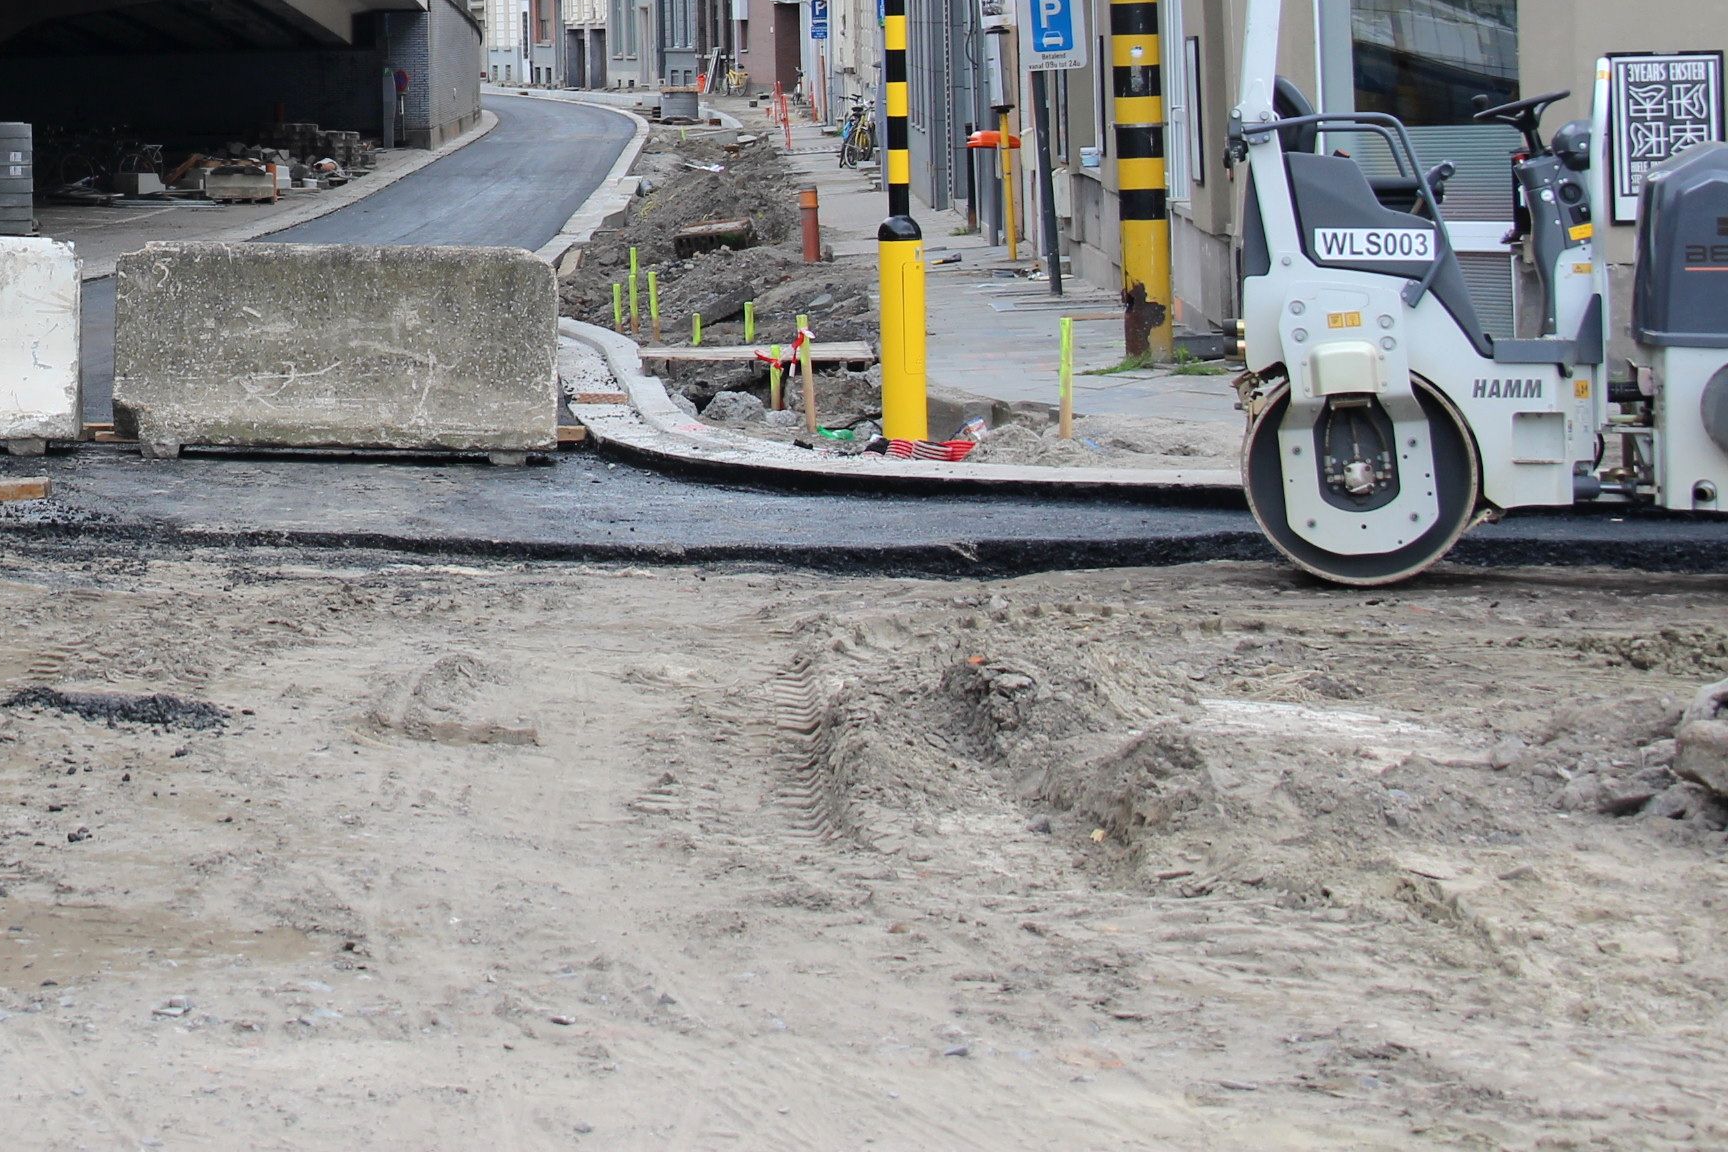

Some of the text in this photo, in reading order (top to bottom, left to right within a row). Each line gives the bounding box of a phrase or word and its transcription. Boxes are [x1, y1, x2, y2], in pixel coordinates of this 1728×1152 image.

[1669, 61, 1706, 81] EKSTER
[1322, 232, 1428, 256] WLS003
[1473, 379, 1542, 398] HAMM
